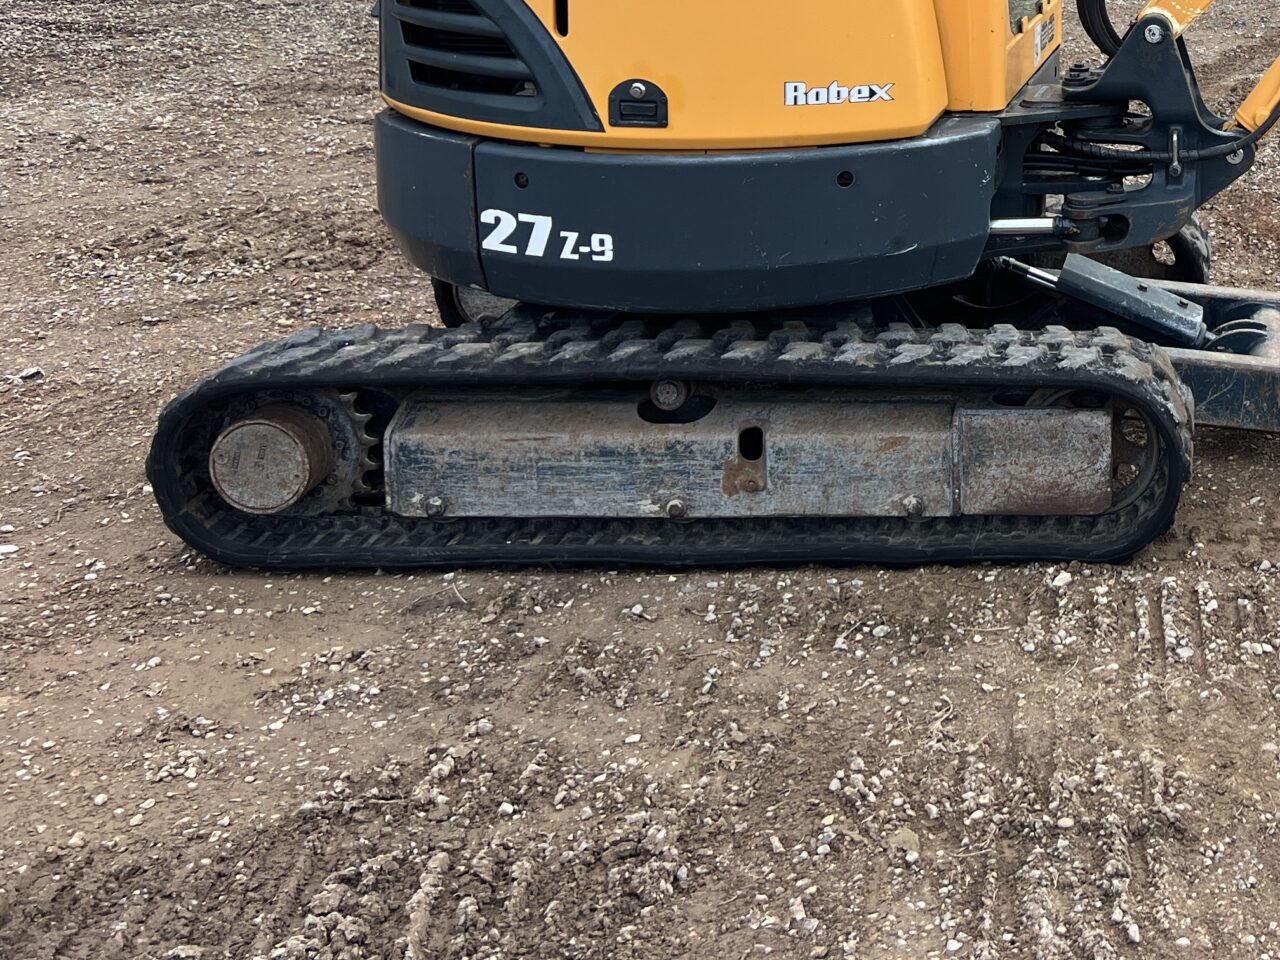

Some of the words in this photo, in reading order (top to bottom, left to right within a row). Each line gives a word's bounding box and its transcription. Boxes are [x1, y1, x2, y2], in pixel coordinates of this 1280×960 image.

[784, 80, 895, 106] Robex
[480, 208, 553, 257] 27
[559, 230, 614, 262] Z-9
